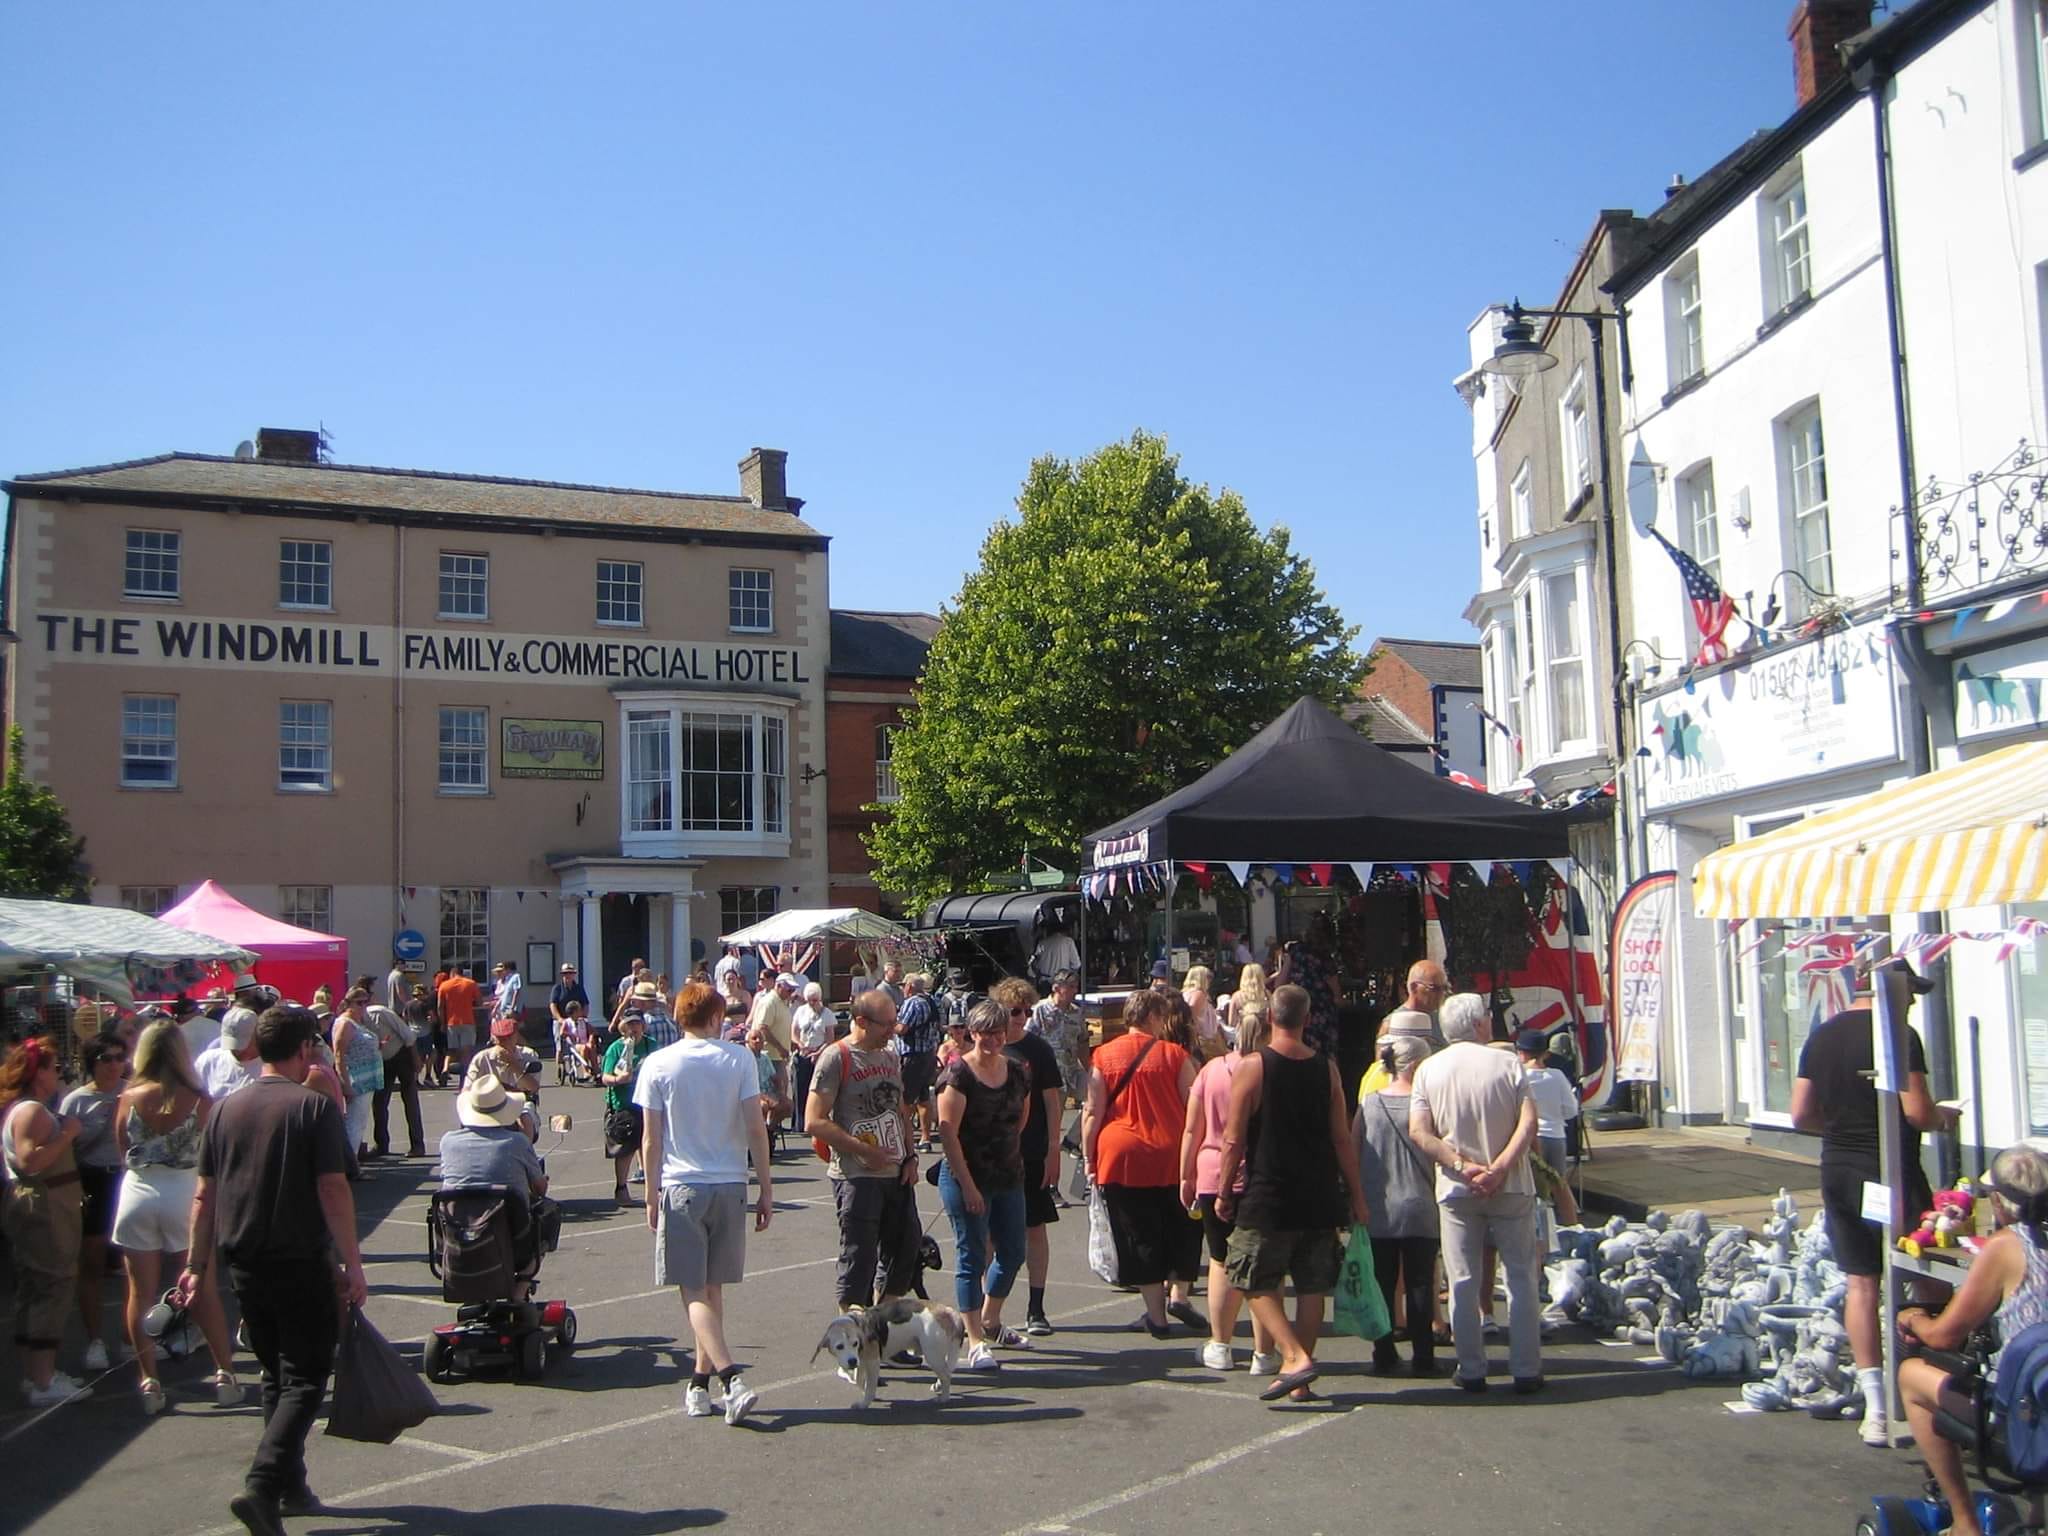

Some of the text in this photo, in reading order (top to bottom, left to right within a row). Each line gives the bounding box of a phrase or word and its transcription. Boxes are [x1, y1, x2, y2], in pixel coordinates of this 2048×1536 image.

[37, 615, 380, 667] THE WINDMILL
[404, 634, 505, 672] FAMILY
[522, 640, 708, 681] COMMERCIAL
[716, 648, 809, 683] HOTEL
[1624, 939, 1663, 955] SHOP
[1624, 960, 1661, 975] LOCAL
[1624, 979, 1658, 997] STAY
[1624, 1001, 1658, 1018] SAFE
